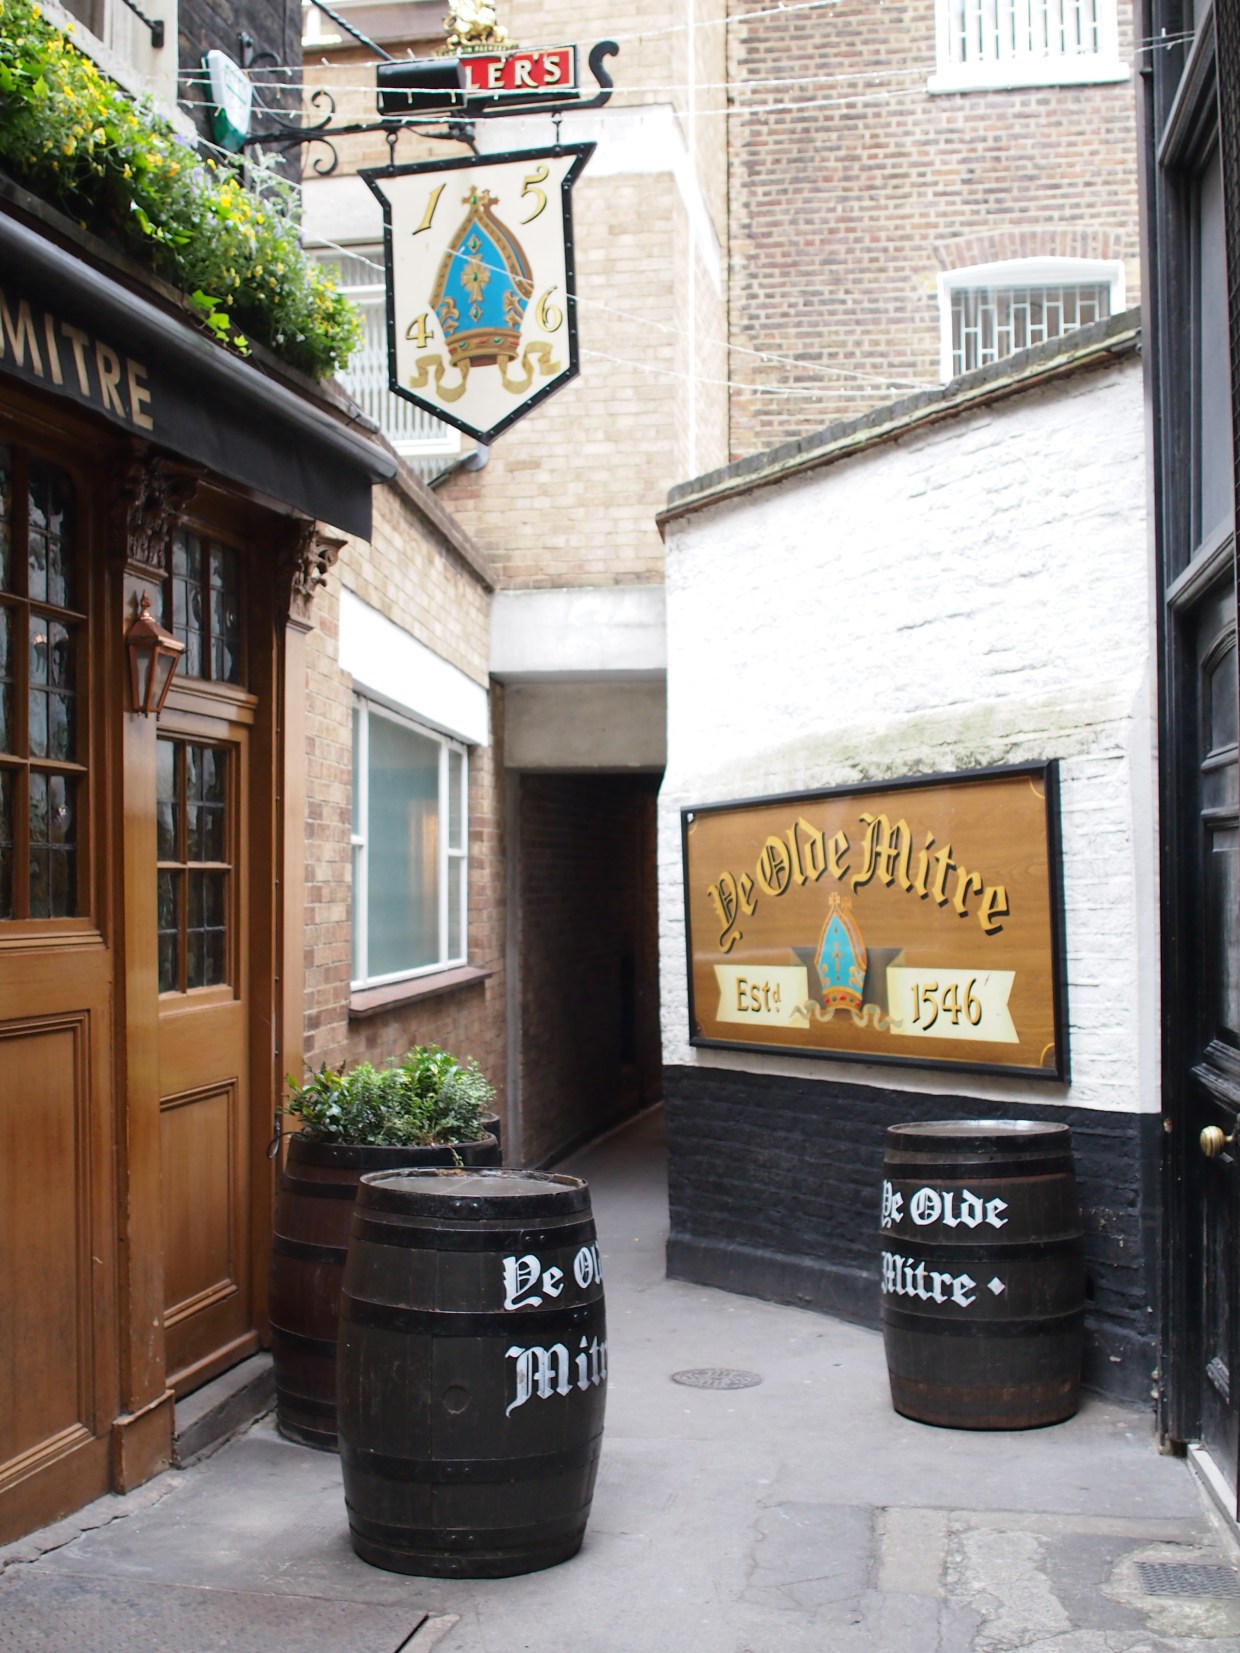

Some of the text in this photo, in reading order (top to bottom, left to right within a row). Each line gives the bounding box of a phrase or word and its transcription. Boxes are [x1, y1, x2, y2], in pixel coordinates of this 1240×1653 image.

[411, 163, 549, 235] 1 5
[405, 285, 563, 349] 4 6
[0, 289, 154, 431] MITRE
[707, 812, 1010, 954] Ye Olde Mitre
[911, 978, 982, 1031] 1546
[910, 1187, 1009, 1229] Olde
[502, 1240, 602, 1311] Ye Ol
[881, 1251, 977, 1308] Mitre
